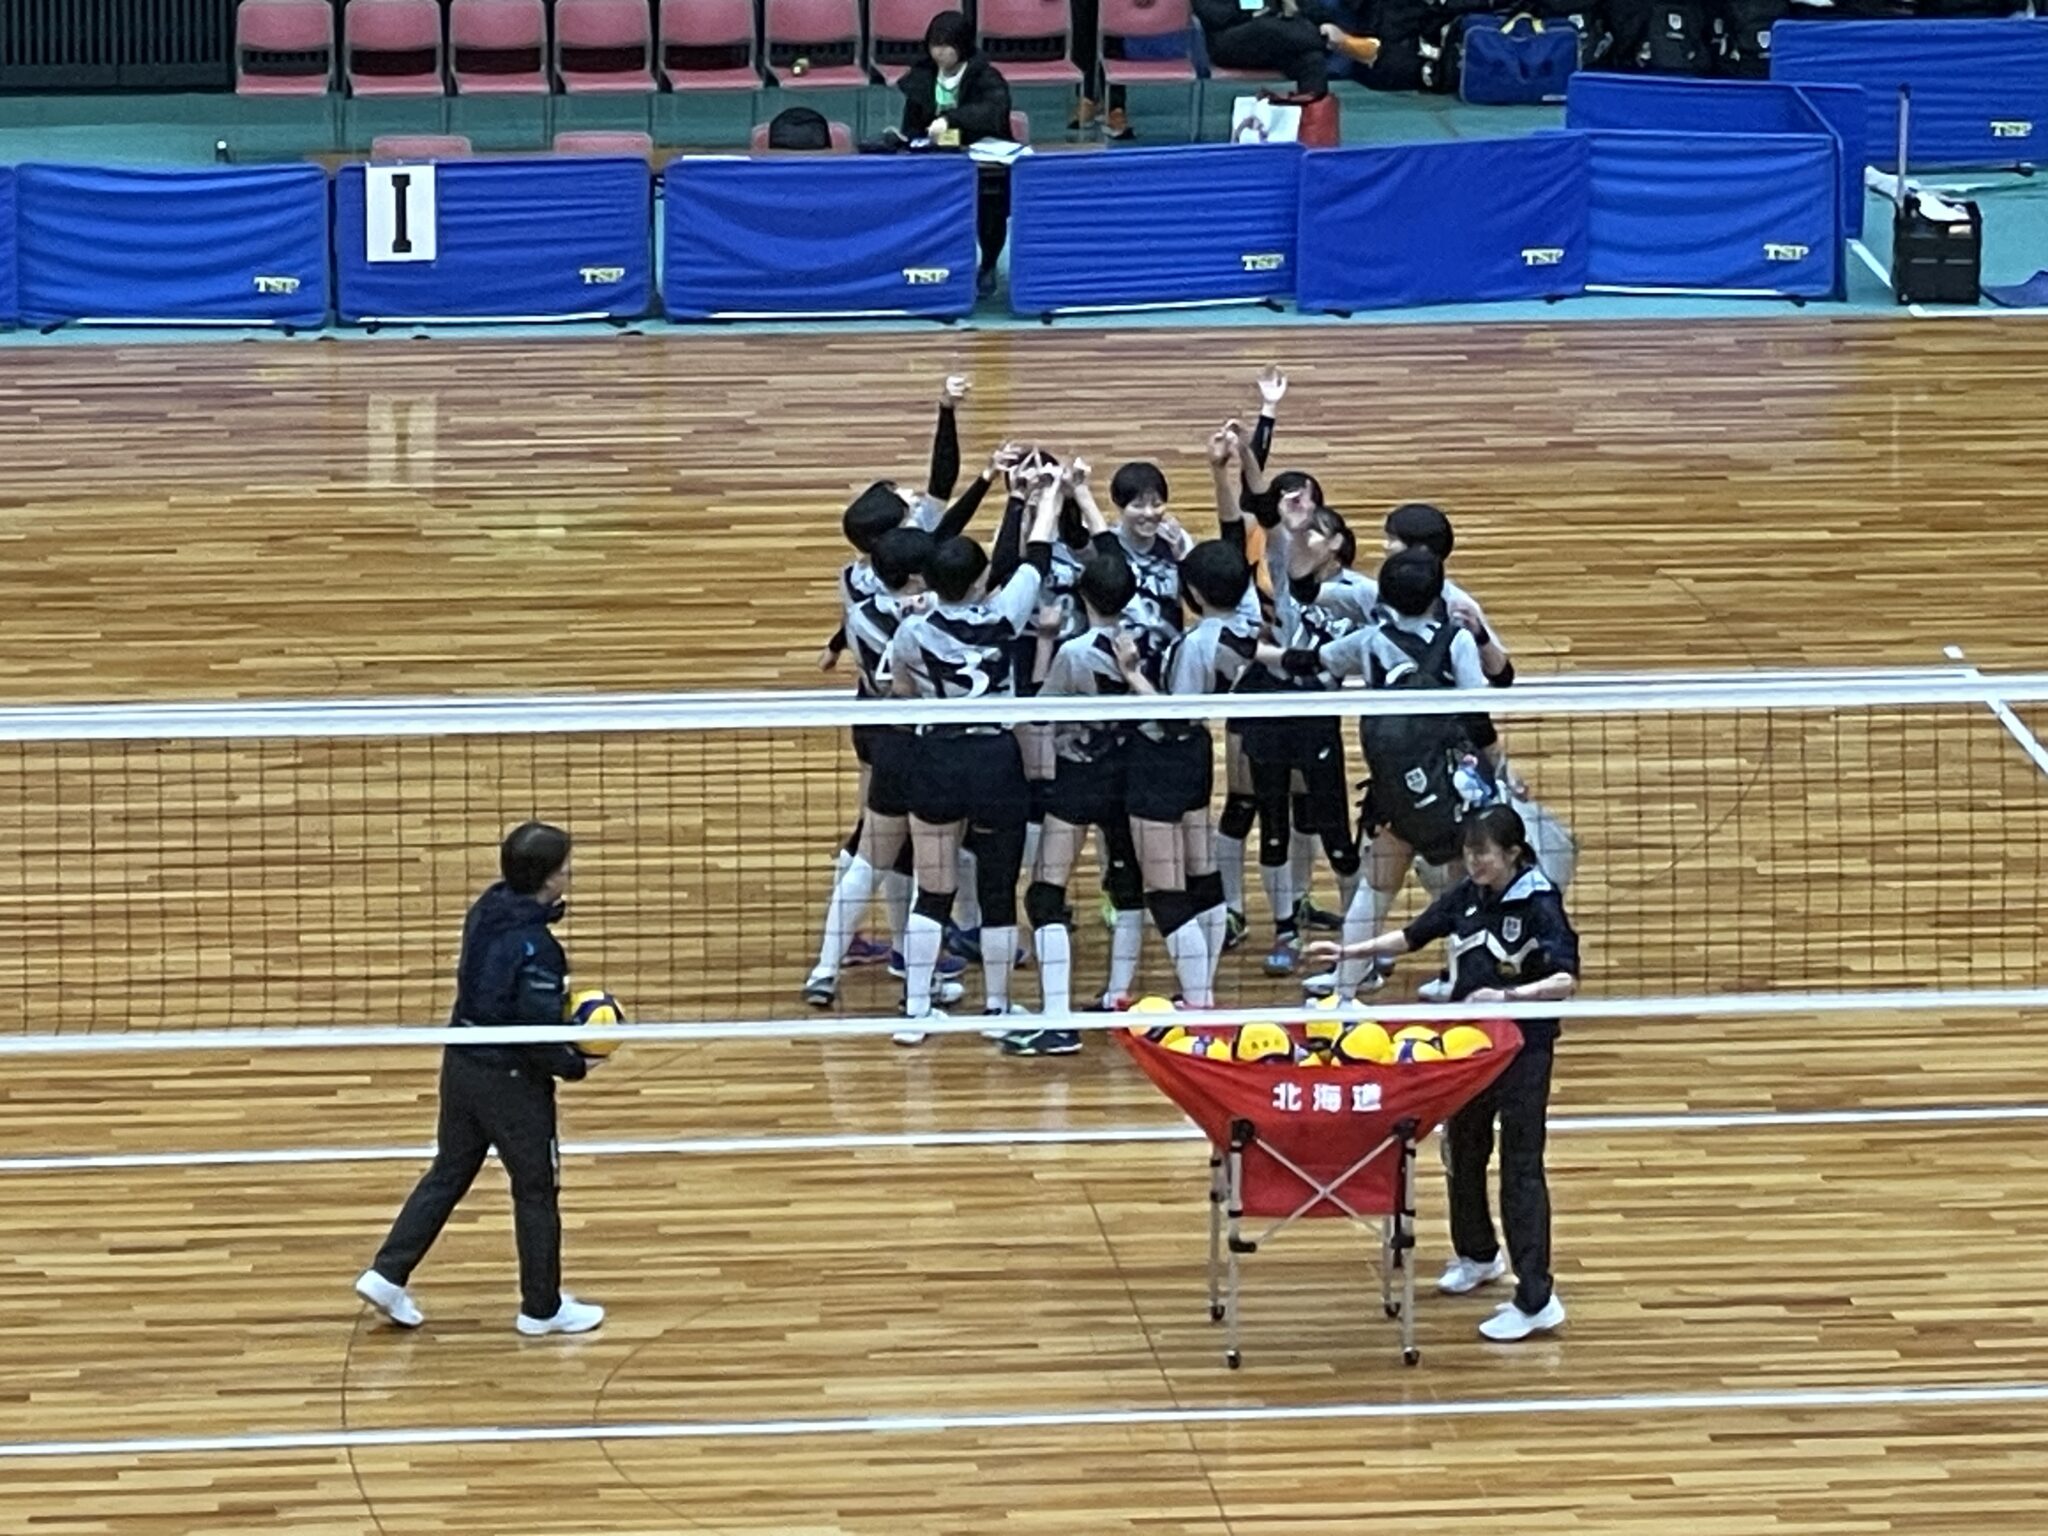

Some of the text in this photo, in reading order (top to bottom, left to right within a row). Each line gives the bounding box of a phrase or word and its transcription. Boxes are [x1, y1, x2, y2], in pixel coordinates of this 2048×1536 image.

[1521, 248, 1565, 266] TSP
[1763, 242, 1810, 261] TSP
[1241, 253, 1285, 271] TSP
[253, 276, 301, 294] TSP
[579, 267, 625, 285] TSP
[902, 267, 950, 285] TSP
[1272, 1082, 1383, 1113] 北海道
